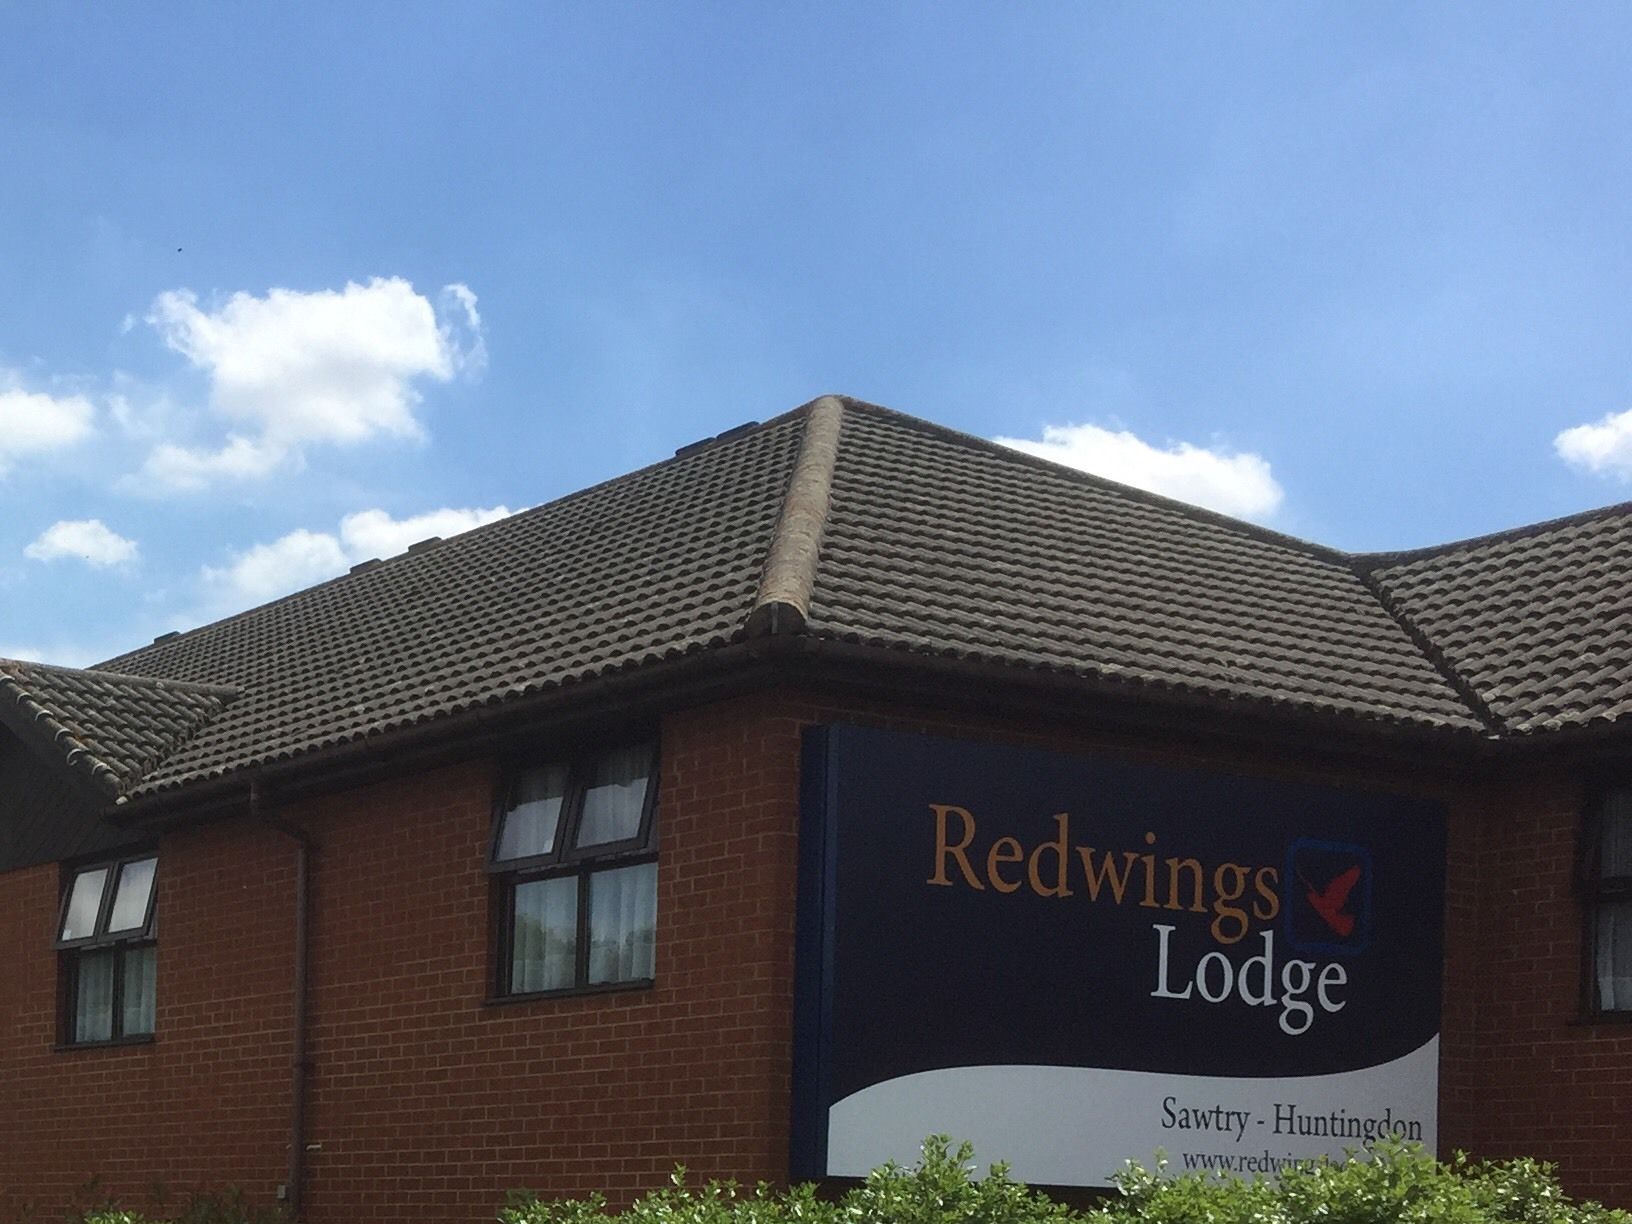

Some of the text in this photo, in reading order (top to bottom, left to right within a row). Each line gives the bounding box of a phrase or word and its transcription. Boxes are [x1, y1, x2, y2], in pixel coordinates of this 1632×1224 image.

[926, 803, 1280, 945] Redwings
[1150, 924, 1348, 1036] Lodge
[1161, 1096, 1251, 1143] Sawtry
[1273, 1103, 1423, 1153] Huntingdon
